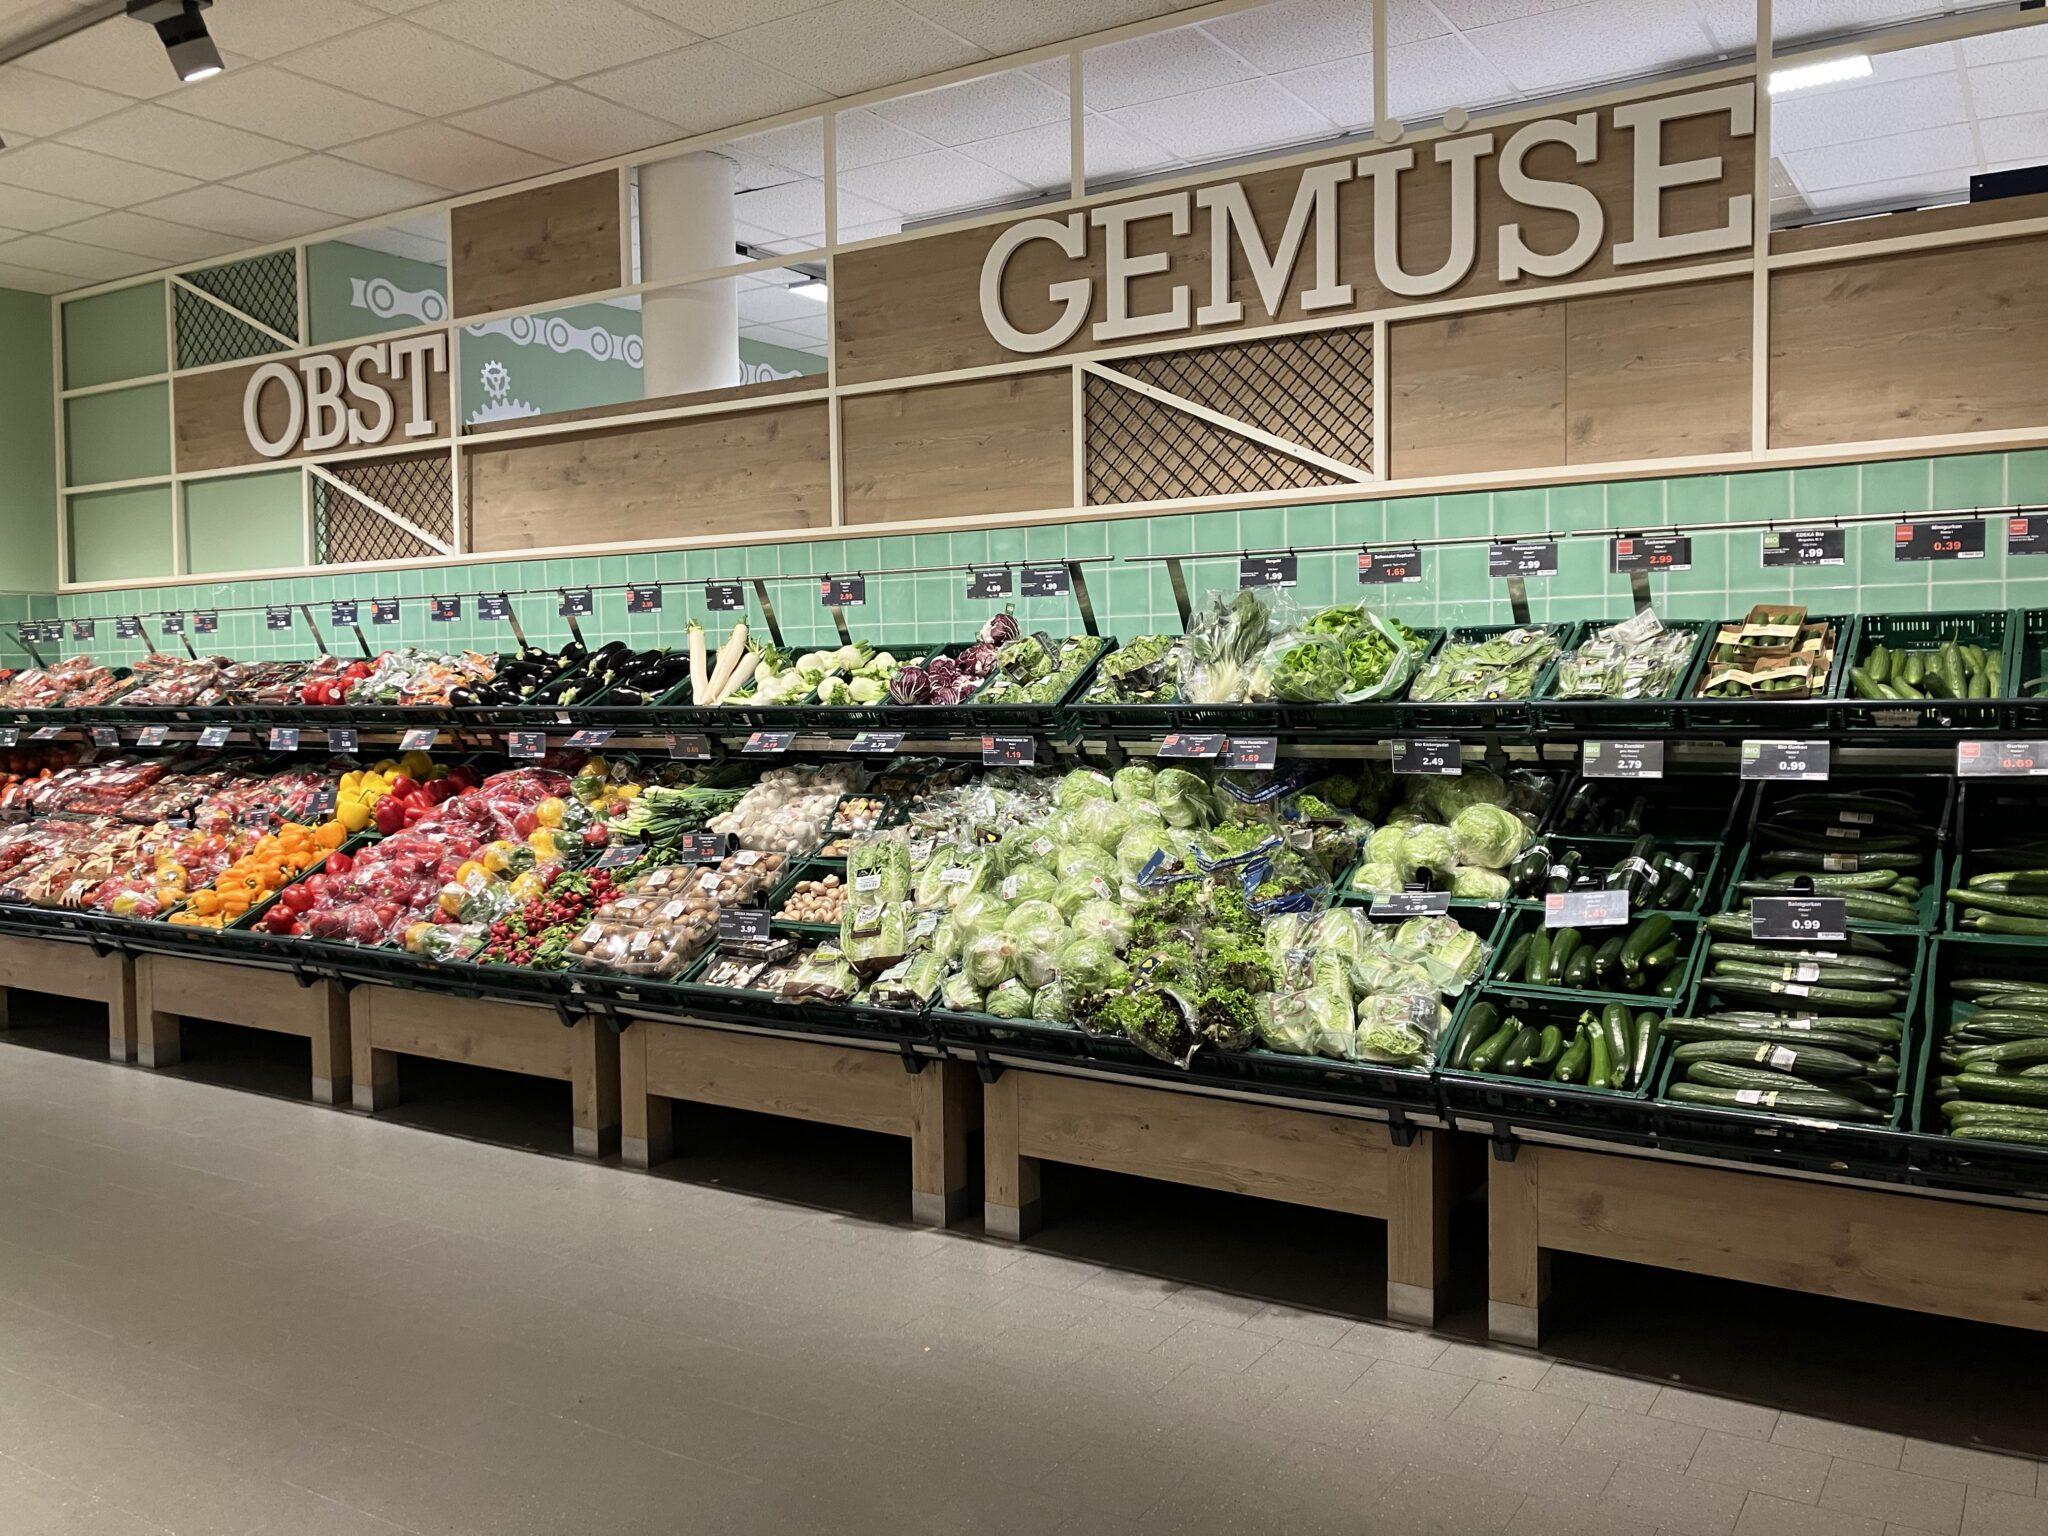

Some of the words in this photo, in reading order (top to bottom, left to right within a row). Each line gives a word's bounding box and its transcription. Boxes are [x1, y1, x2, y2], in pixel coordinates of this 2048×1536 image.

[978, 82, 1756, 354] GEMÜSE
[243, 332, 446, 458] OBST
[1764, 536, 1778, 544] BIO
[1933, 541, 1961, 551] 0.39
[1798, 548, 1824, 558] 1.99
[1650, 555, 1672, 564] 2.99
[1518, 560, 1540, 569] 2.99
[1264, 572, 1282, 580] 1.99
[1386, 568, 1406, 576] 1.69
[1240, 754, 1259, 762] 1.69
[1422, 757, 1444, 766] 2.49
[1617, 760, 1642, 769] 2.79
[1778, 761, 1806, 771] 0.99
[740, 925, 757, 933] 3.99
[1792, 920, 1821, 930] 0.99
